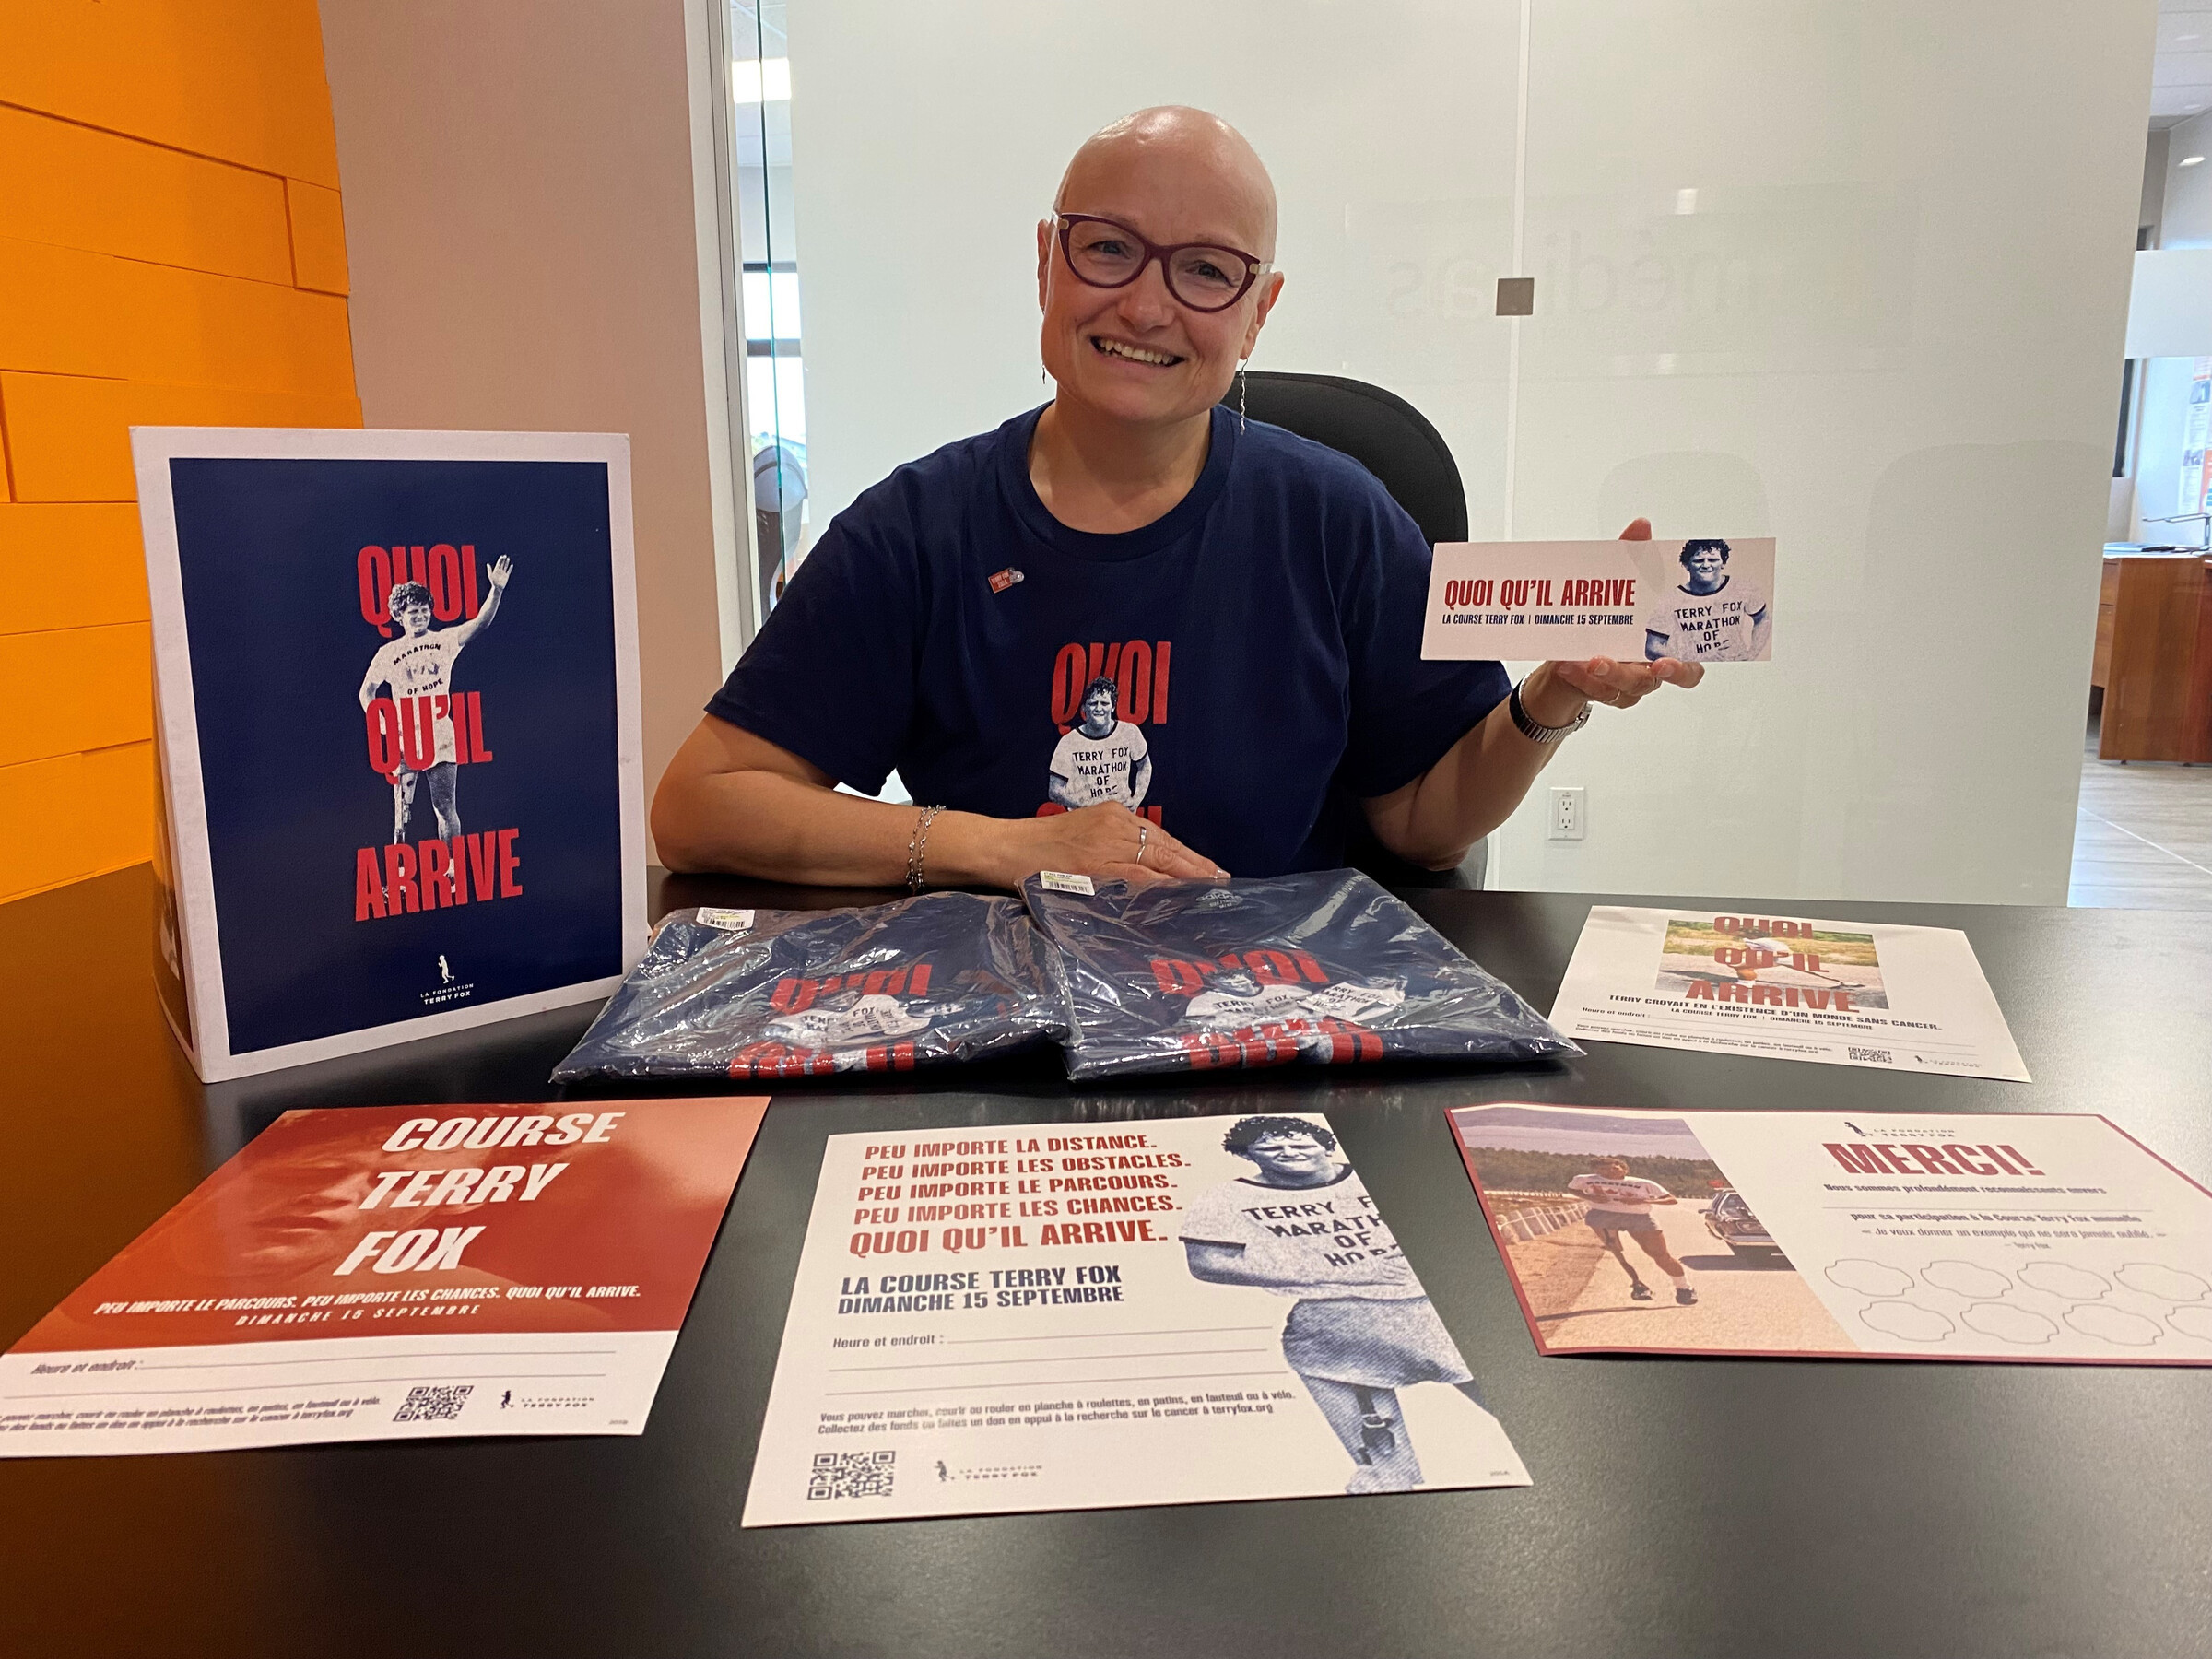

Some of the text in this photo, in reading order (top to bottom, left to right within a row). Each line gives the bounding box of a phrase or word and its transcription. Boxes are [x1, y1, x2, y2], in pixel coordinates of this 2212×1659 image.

[1444, 579, 1636, 610] QUOI QU'IL ARRIVE
[1442, 614, 1633, 625] LA COURSE TERRY FOX DIMANCHE 15 SEPTEMBRE
[1674, 601, 1743, 619] TERRY FOX
[1680, 615, 1741, 632] MARATHON
[1703, 629, 1720, 641] OF
[393, 642, 441, 665] MARATHON
[407, 678, 443, 696] OF HOPE
[366, 691, 493, 784] QU'IL
[1072, 747, 1129, 762] TERRY FOX
[1077, 761, 1127, 775] MARATHON
[1097, 775, 1110, 785] OF
[356, 828, 523, 921] ARRIVE
[1714, 947, 1829, 972] QU'IL
[424, 990, 471, 1005] TERRY FOX
[433, 983, 474, 995] FONDATION
[1685, 981, 1860, 1013] ARRIVE
[1609, 994, 1641, 1004] TERRY
[1645, 998, 1690, 1009] CROYAIT
[1711, 1004, 1777, 1016] L'EXISTENCE
[1781, 1010, 1809, 1018] D'UN
[1812, 1012, 1853, 1022] MONDE
[1856, 1017, 1888, 1026] SANS
[1891, 1019, 1943, 1030] CANCER.
[1770, 1016, 1812, 1025] DIMANCHE
[1827, 1021, 1874, 1030] SEPTEMBRE
[382, 1112, 626, 1152] COURSE
[865, 1135, 1158, 1160] PEU IMPORTE LA DISTANCE.
[1821, 1143, 2046, 1176] MERCI!
[862, 1153, 1191, 1181] PEU IMPORTE LES OBSTACLES.
[358, 1162, 570, 1210] TERRY
[858, 1174, 1178, 1202] PEU IMPORTE LE PARCOURS.
[853, 1195, 1183, 1225] PEU IMPORTE LES CHANCES.
[1241, 1201, 1335, 1221] TERRY
[1265, 1212, 1383, 1238] MARATH
[332, 1225, 487, 1277] FOX
[849, 1219, 1168, 1259] QUOI QU'IL ARRIVE.
[1333, 1230, 1371, 1248] OF
[841, 1265, 1122, 1295] LA COURSE TERRY FOX
[93, 1285, 641, 1314] PEU IMPORTE LE PARCOURS. PEU IMPORTE LES CHANCES. QUOI QU'IL ARRIVE.
[838, 1286, 1124, 1314] DIMANCHE 15 SEPTEMBRE
[235, 1304, 480, 1326] DIMANCHE 15 SEPTEMBRE
[832, 1334, 935, 1348] Heure et endroit
[818, 1423, 865, 1434] Collectez
[868, 1422, 887, 1432] des
[971, 1418, 982, 1427] un
[986, 1416, 1006, 1426] don
[1008, 1417, 1021, 1425] en
[1024, 1414, 1053, 1426] appui
[1065, 1412, 1074, 1422] la
[1077, 1409, 1129, 1421] recherche
[1132, 1409, 1148, 1418] sur
[1151, 1407, 1161, 1418] le
[1164, 1406, 1199, 1417] cancer
[1212, 1403, 1273, 1416] terryfox.org
[820, 1412, 844, 1422] Vous
[847, 1411, 884, 1423] pouvez
[970, 1406, 982, 1415] ou
[985, 1404, 1015, 1414] rouler
[1018, 1404, 1031, 1412] en
[1034, 1400, 1073, 1414] planche
[1137, 1396, 1150, 1406] en
[1191, 1394, 1204, 1403] en
[1206, 1391, 1243, 1403] fauteuil
[1246, 1392, 1259, 1401] ou
